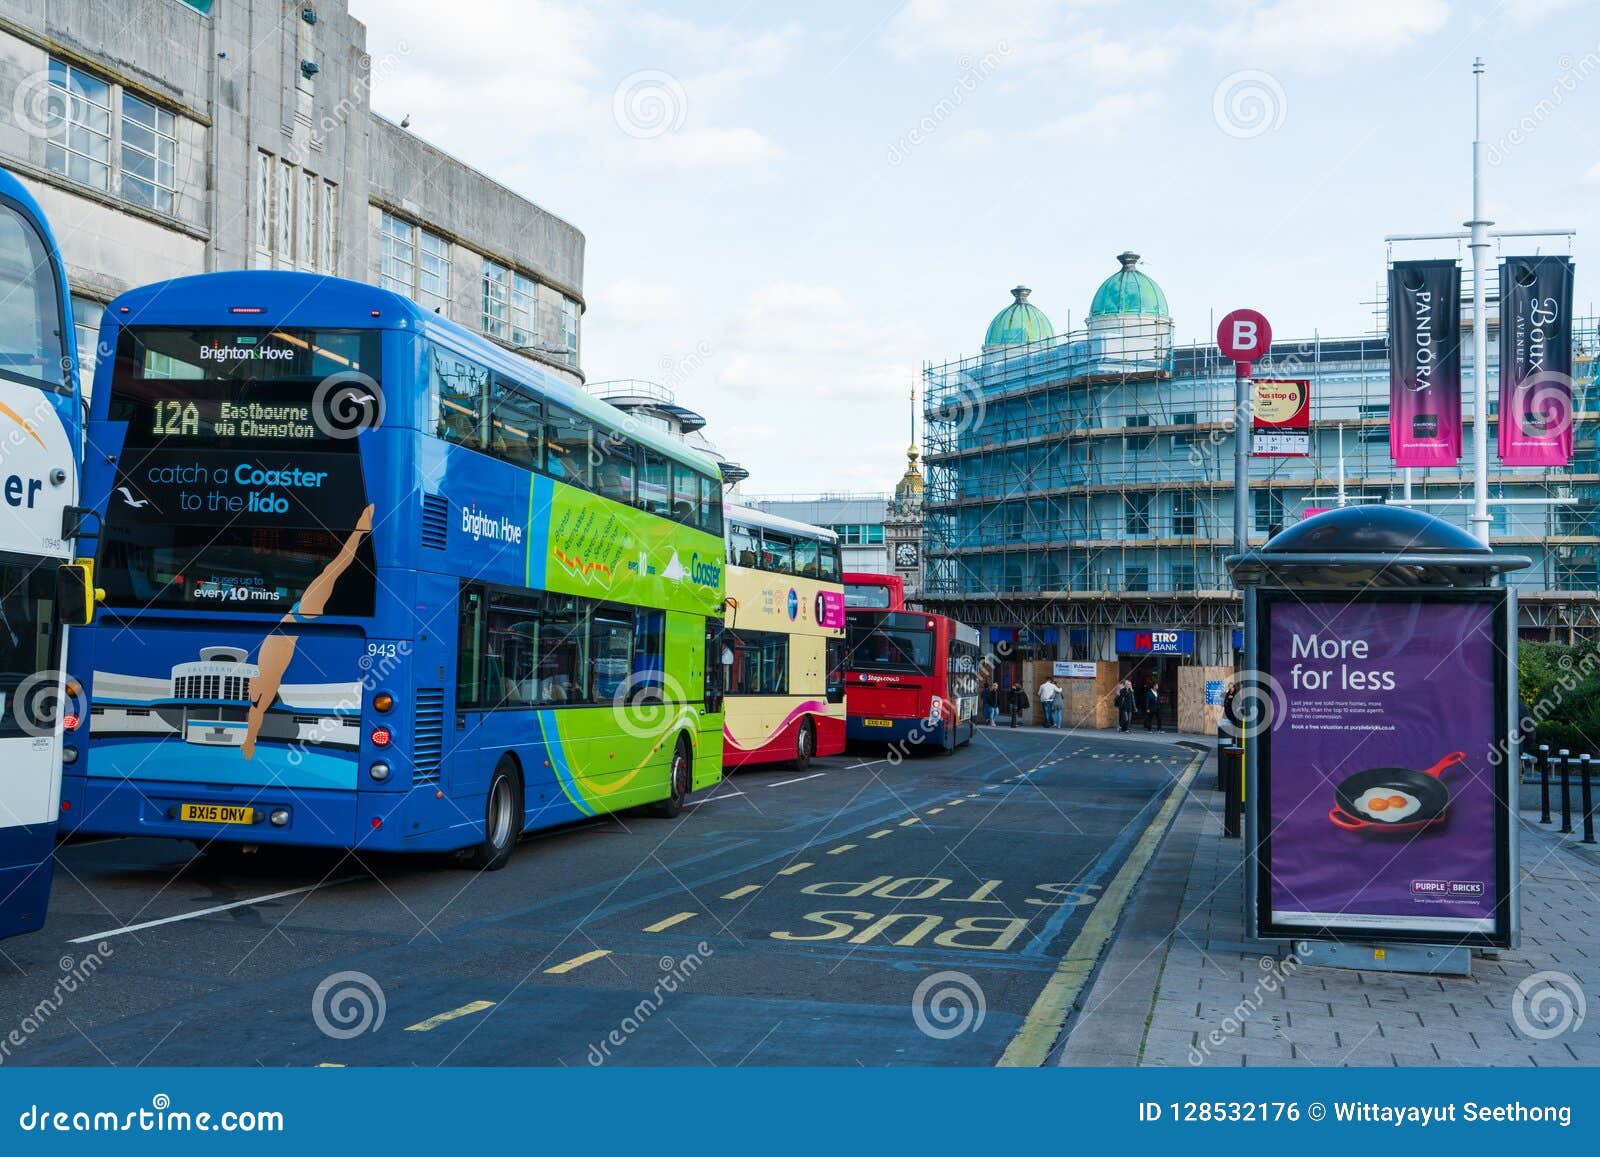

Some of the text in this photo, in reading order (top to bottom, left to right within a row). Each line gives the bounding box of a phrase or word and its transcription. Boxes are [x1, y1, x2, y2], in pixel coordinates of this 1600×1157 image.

[1232, 320, 1258, 350] B
[1416, 291, 1433, 393] PANDORA
[1517, 315, 1526, 364] AVENUE
[1520, 297, 1559, 388] Boux
[1271, 392, 1287, 400] stop
[153, 400, 308, 435] 12A Eastbourne
[214, 420, 314, 437] via Chyngton
[148, 463, 328, 487] catch a Coaster
[4, 474, 42, 509] er
[180, 490, 289, 513] to the lido
[240, 576, 253, 587] up
[254, 575, 264, 586] to
[691, 552, 721, 588] Coaster
[194, 587, 280, 602] every 10 mins
[368, 644, 396, 657] 943
[1135, 631, 1178, 650] METRO
[1153, 643, 1177, 651] BANK
[1291, 633, 1369, 659] More
[1290, 663, 1396, 691] for less
[189, 806, 246, 821] BX15 ONV
[1415, 882, 1481, 892] PURPLE BRICKS
[770, 911, 1029, 950] BUS
